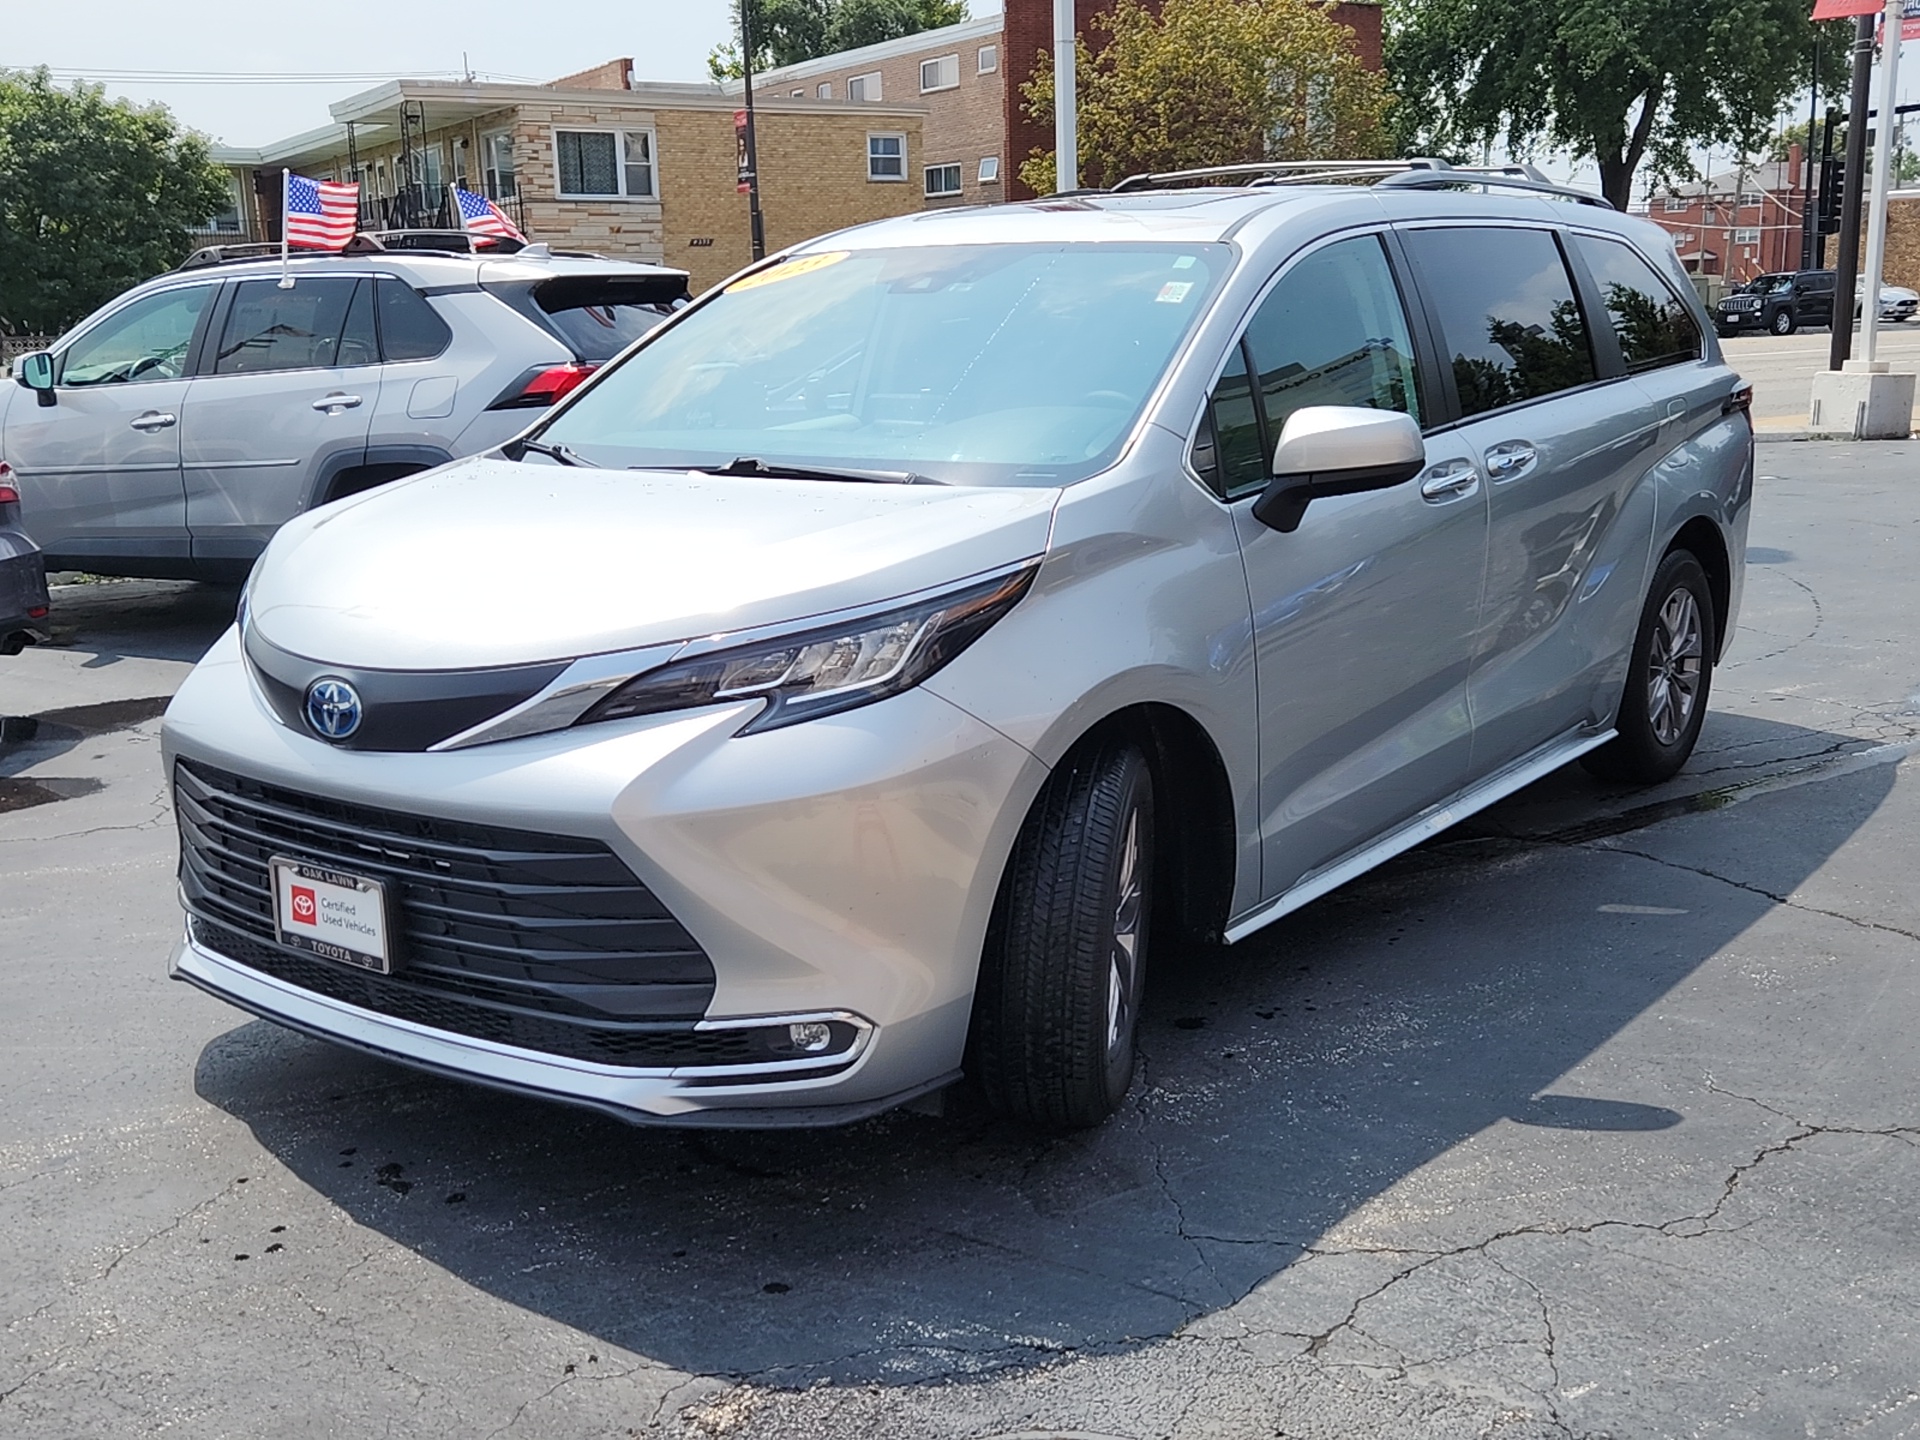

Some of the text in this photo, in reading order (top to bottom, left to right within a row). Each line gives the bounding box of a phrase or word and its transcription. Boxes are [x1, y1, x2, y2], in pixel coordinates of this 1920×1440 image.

[302, 867, 354, 888] OAK LAWN
[321, 897, 356, 916] Certified
[322, 913, 376, 936] Used Vehicles
[311, 940, 352, 962] TOYOTA
